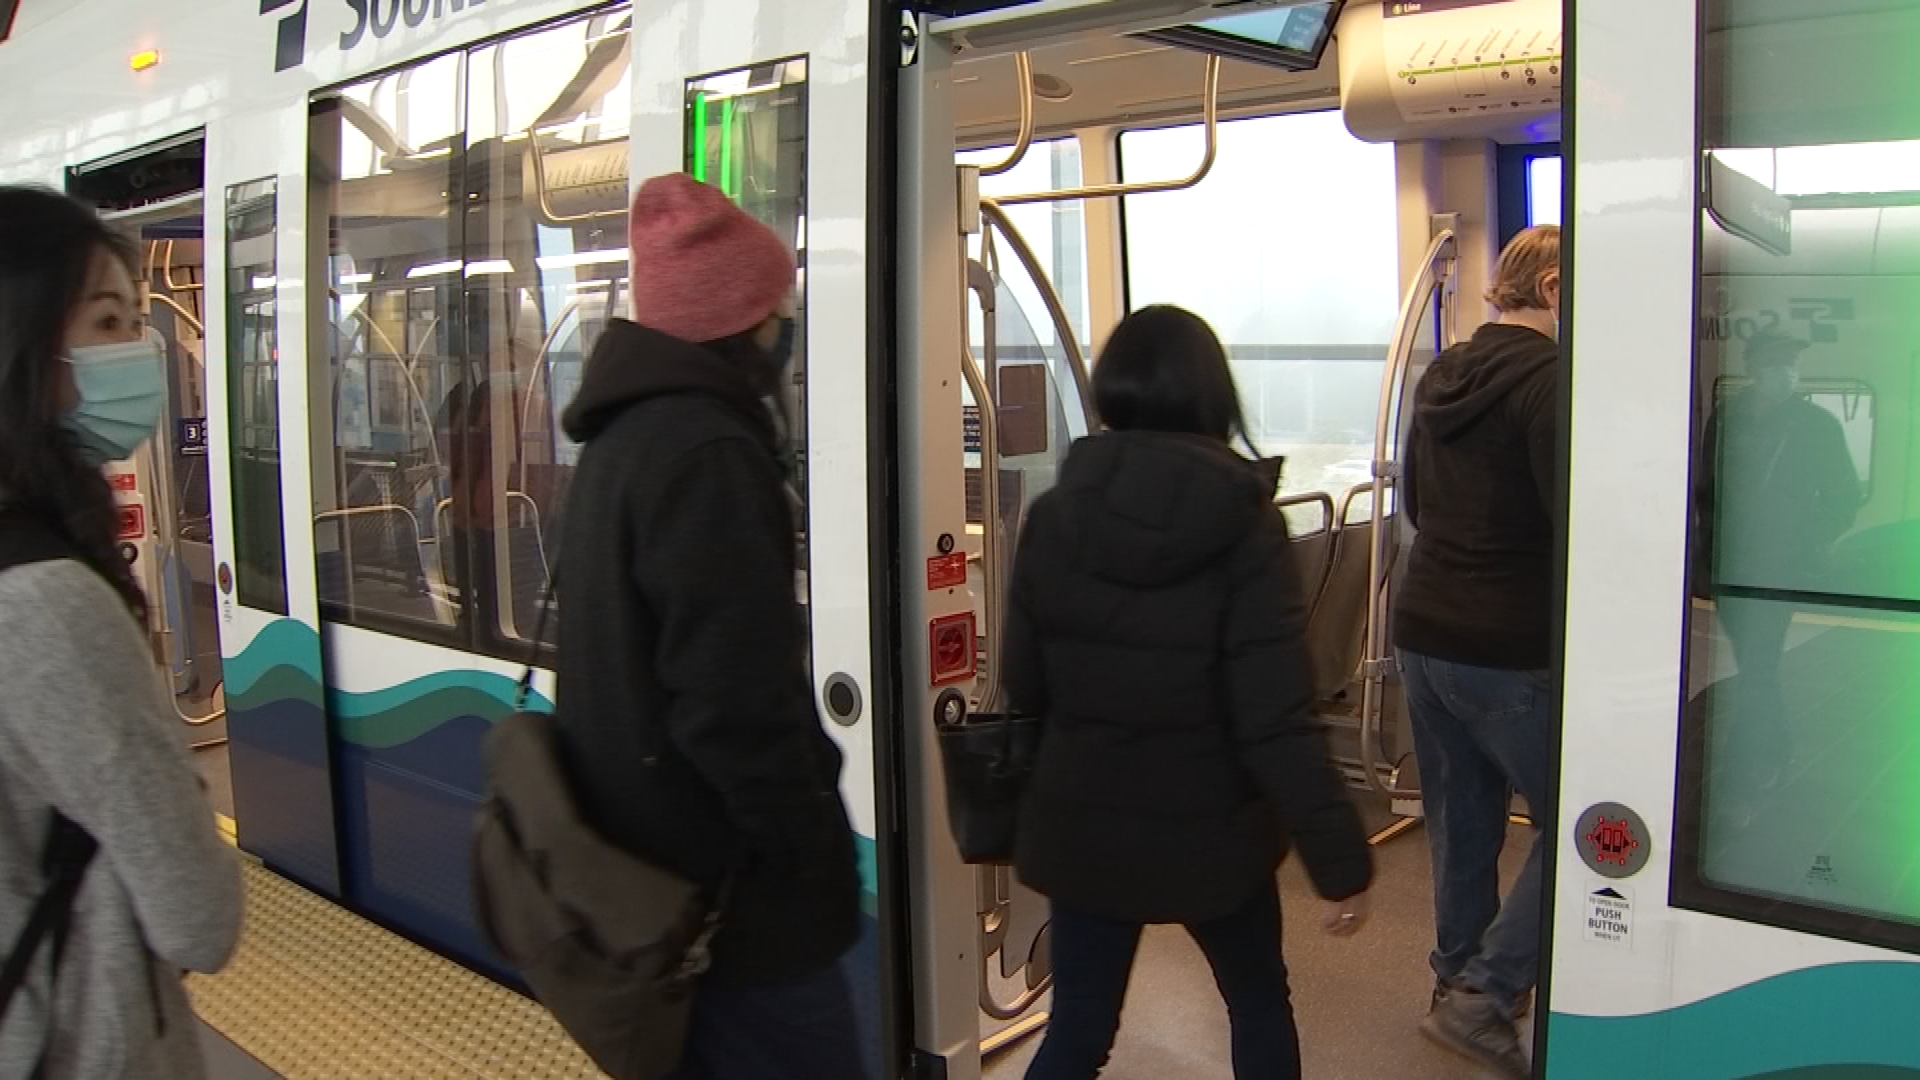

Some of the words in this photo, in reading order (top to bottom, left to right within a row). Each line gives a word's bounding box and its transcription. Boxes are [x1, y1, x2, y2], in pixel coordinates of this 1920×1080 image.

[188, 427, 197, 439] 3
[1595, 906, 1621, 920] PUSH
[1588, 918, 1628, 934] BUTTON
